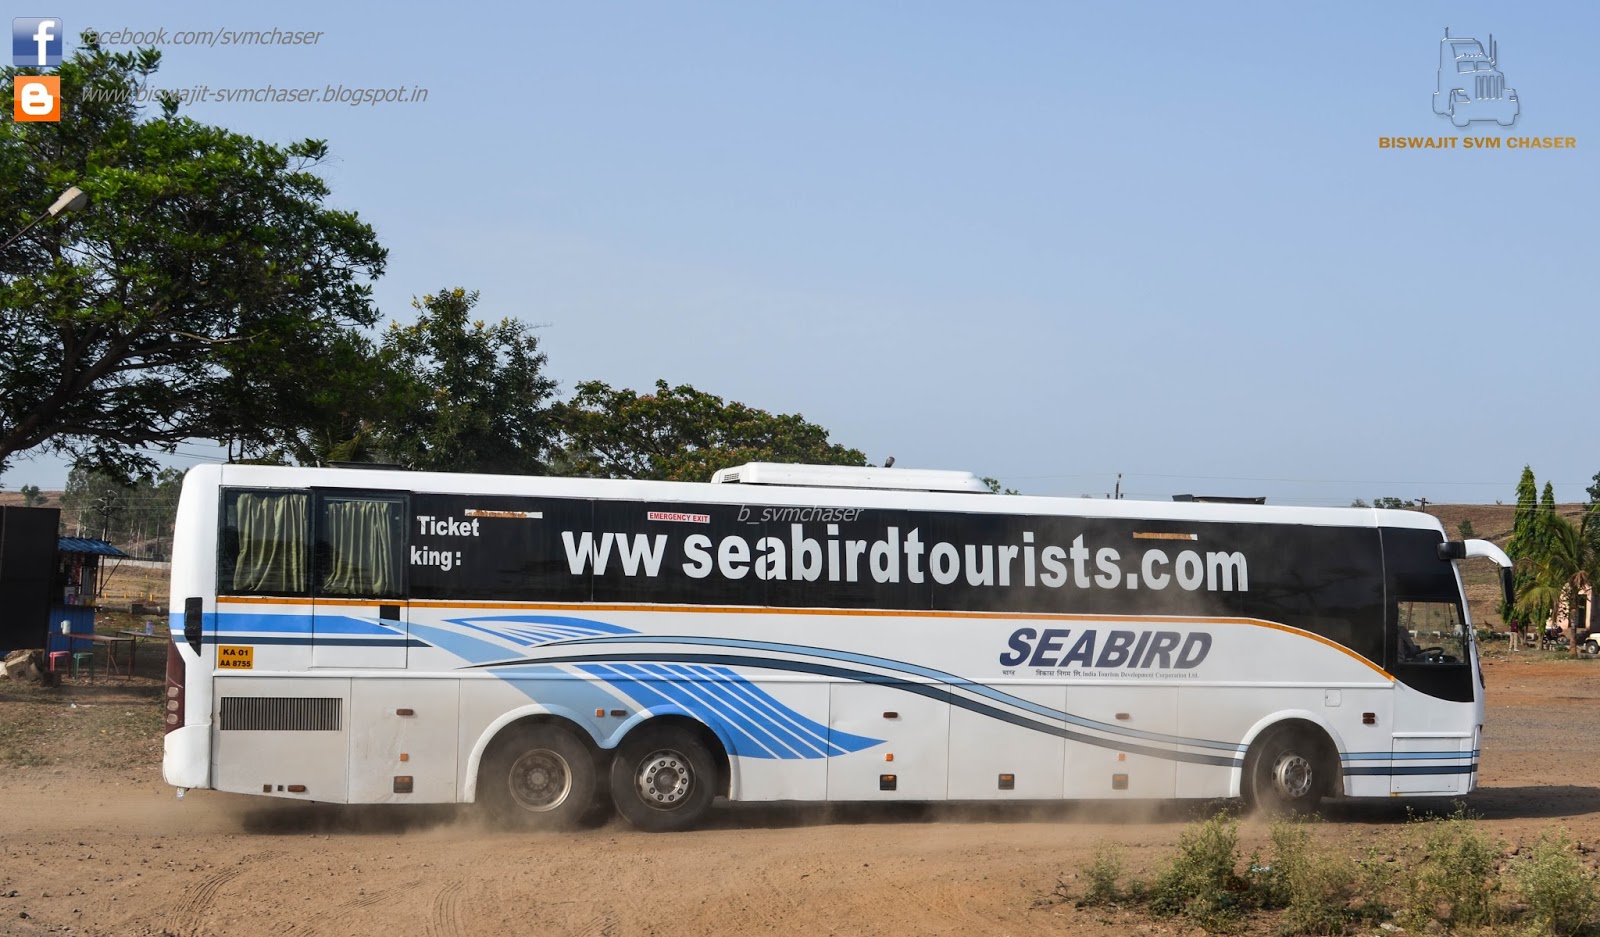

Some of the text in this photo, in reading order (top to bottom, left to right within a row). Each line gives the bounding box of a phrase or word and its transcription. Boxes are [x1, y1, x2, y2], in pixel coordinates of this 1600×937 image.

[416, 515, 480, 537] Ticket
[649, 512, 691, 521] EMERGENCY
[682, 523, 1249, 592] seabirdtourists.com
[999, 627, 1213, 669] SEABIRD
